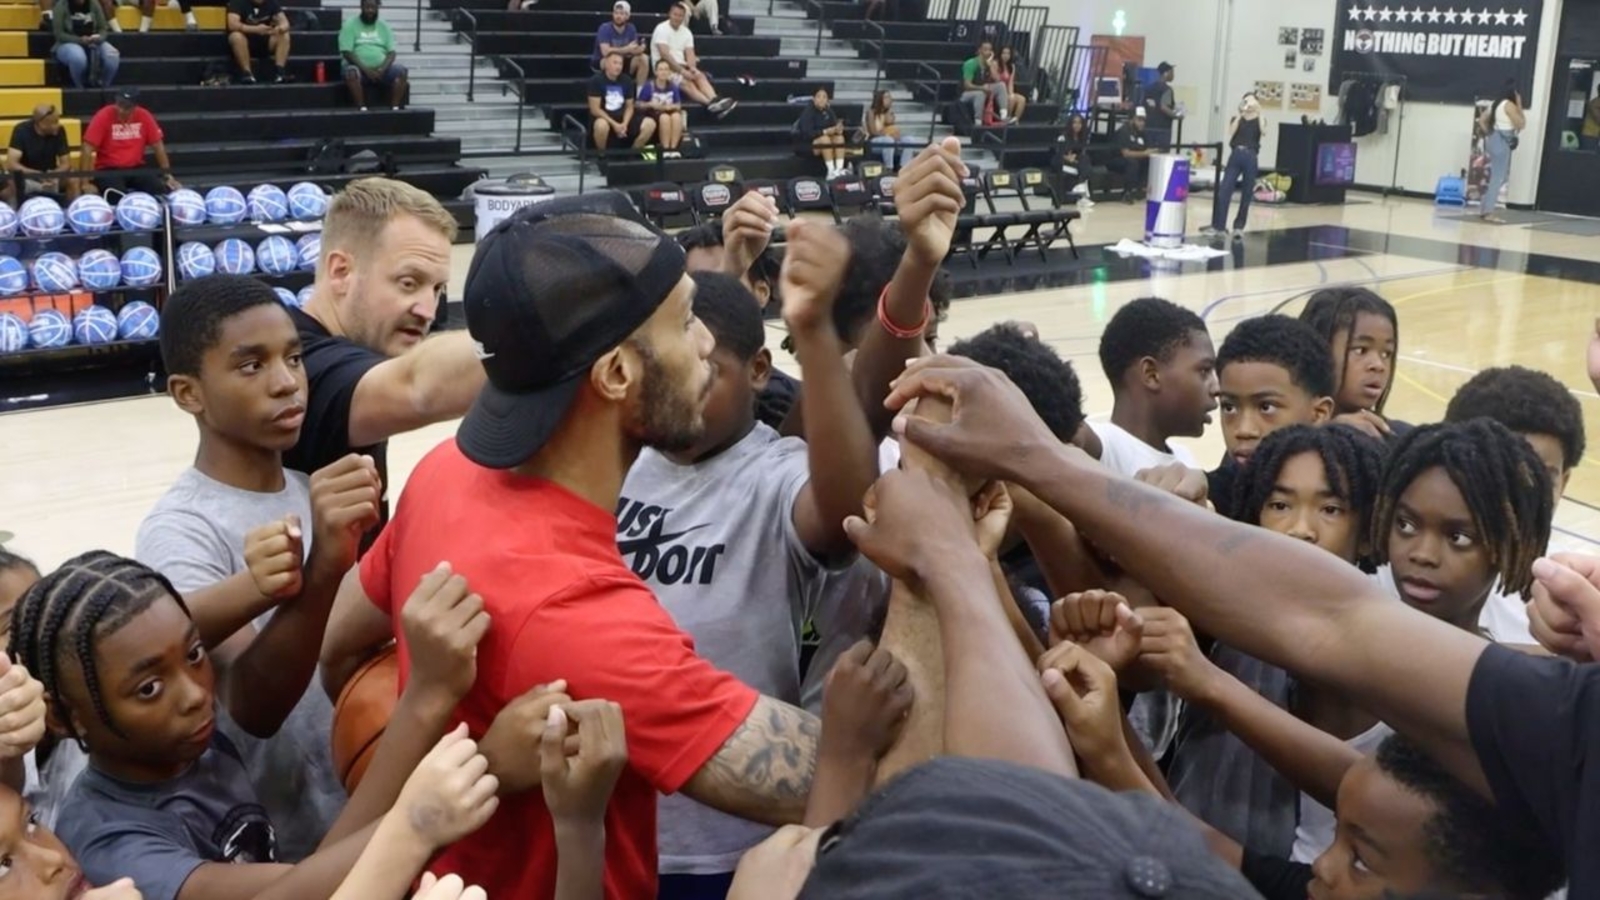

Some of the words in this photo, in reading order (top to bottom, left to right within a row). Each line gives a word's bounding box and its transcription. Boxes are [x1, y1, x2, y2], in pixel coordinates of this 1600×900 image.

[1344, 28, 1427, 55] NOTHING
[1427, 32, 1465, 56] BUT
[1463, 34, 1526, 59] HEART
